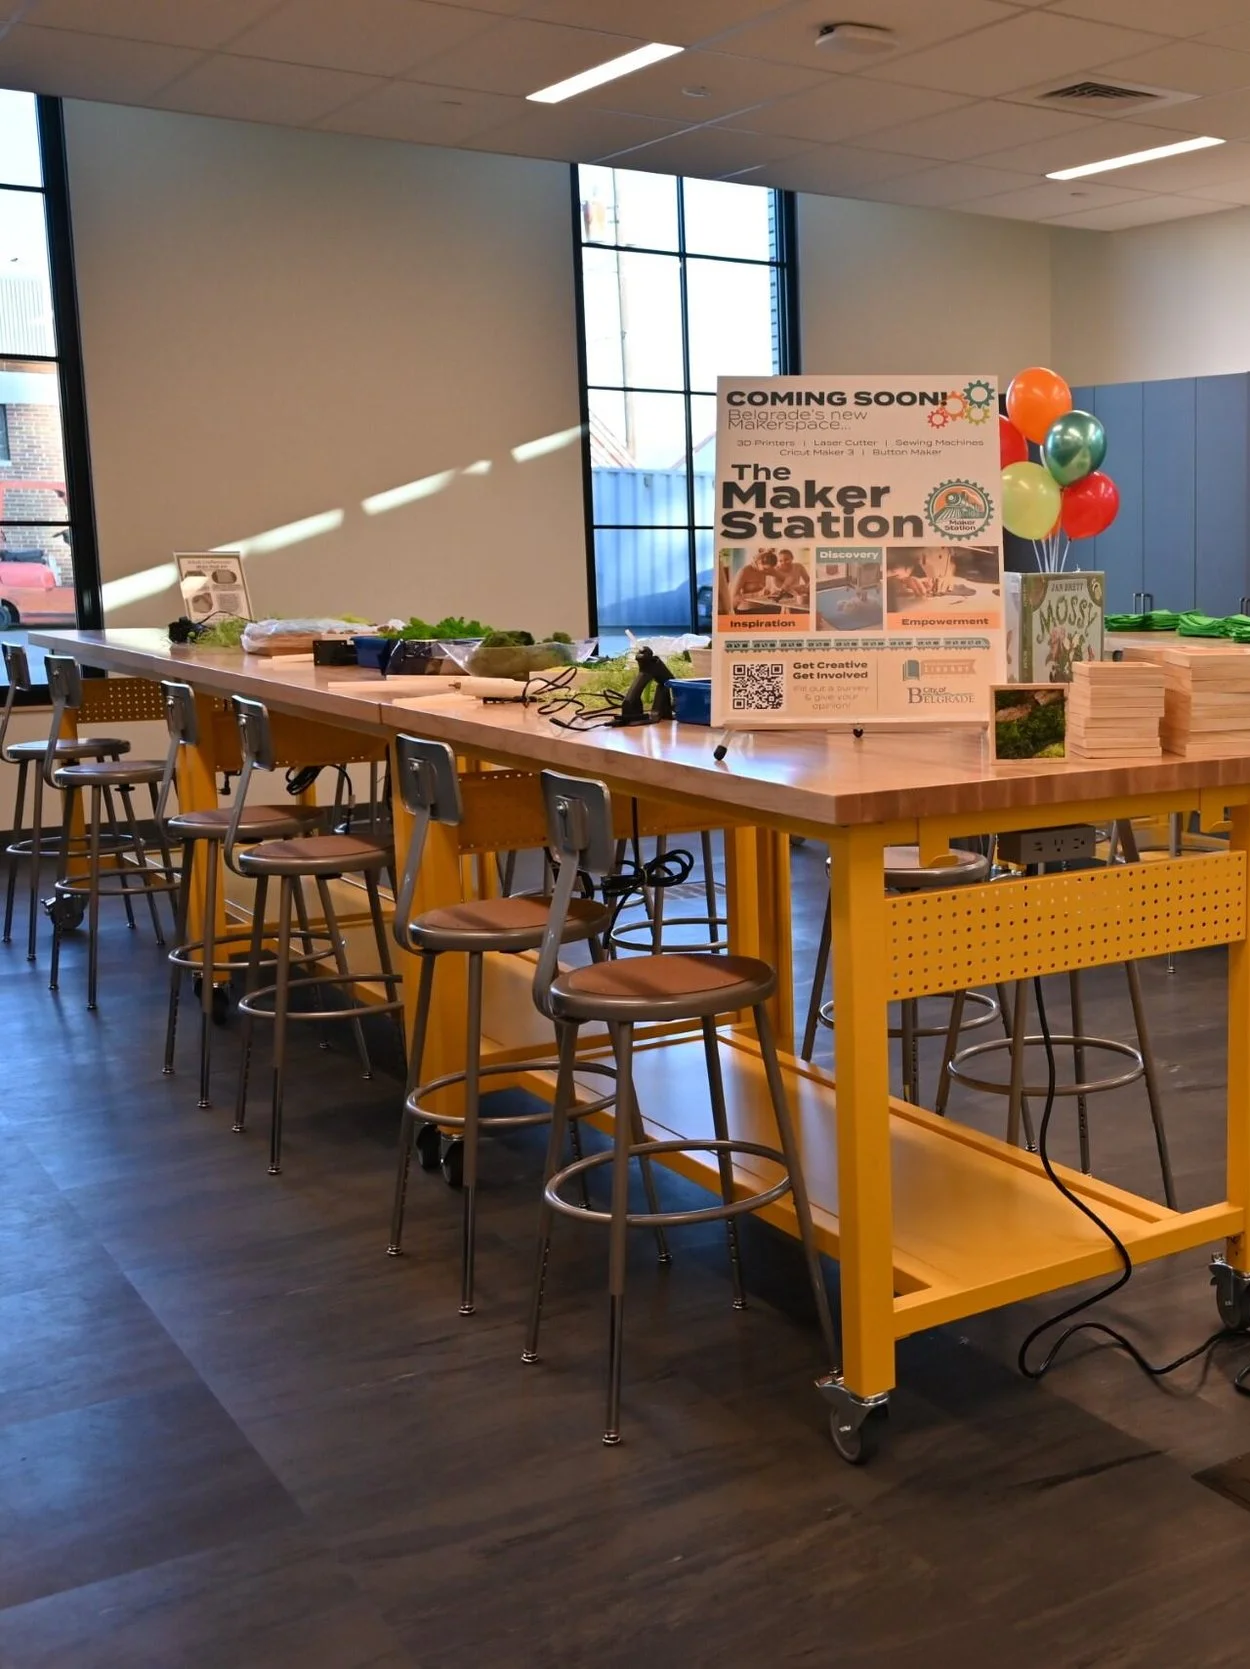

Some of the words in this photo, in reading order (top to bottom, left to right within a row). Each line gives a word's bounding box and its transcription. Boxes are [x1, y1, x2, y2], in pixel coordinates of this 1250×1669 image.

[726, 391, 847, 407] COMING
[853, 391, 948, 407] SOON!
[728, 408, 827, 422] Belgrade's
[831, 410, 868, 420] new
[728, 418, 851, 431] Makerspace...
[755, 439, 795, 447] Printers
[814, 439, 842, 447] Laser
[845, 439, 878, 447] Cutter
[895, 439, 932, 447] Sewing
[935, 439, 984, 447] Machines
[731, 464, 791, 481] The
[722, 480, 890, 509] Maker
[720, 505, 923, 540] Station
[819, 550, 879, 560] Discovery
[730, 619, 796, 629] Inspiration
[901, 618, 989, 628] Empowerment
[1036, 596, 1098, 645] MOSSY
[817, 660, 868, 669] Creative
[793, 672, 815, 680] Get
[817, 671, 868, 680] Involved
[907, 687, 975, 704] BELGRADE
